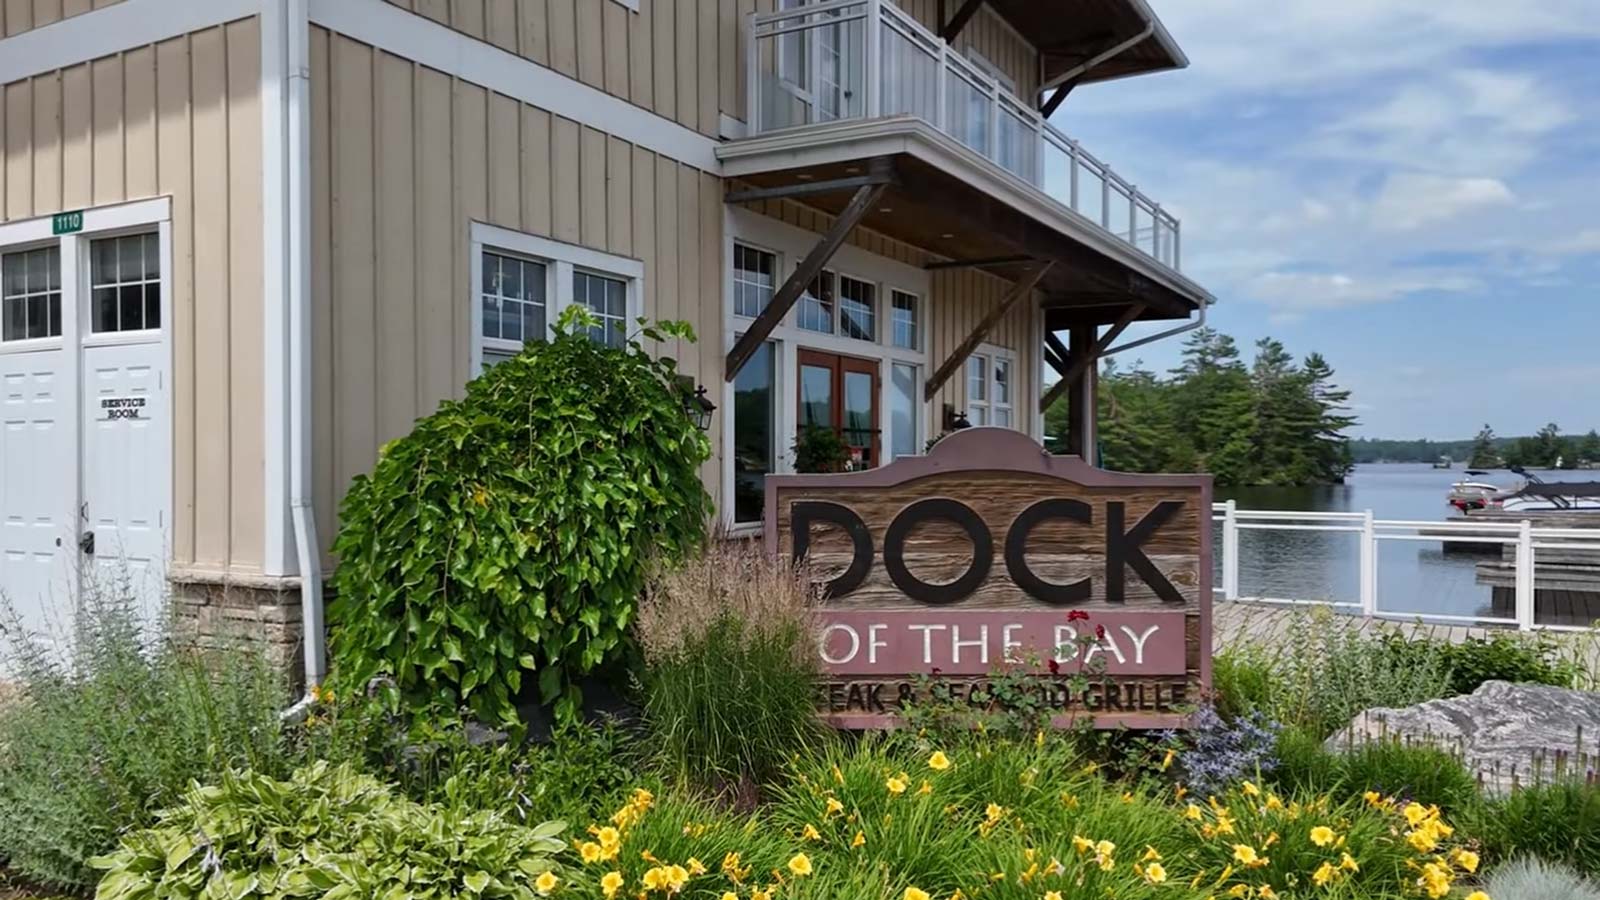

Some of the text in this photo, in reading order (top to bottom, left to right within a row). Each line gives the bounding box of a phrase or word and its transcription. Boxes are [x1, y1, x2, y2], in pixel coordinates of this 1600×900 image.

[57, 213, 80, 230] 1110
[101, 398, 145, 408] SERVICE
[107, 409, 139, 419] ROOM
[791, 497, 1186, 605] DOCK
[819, 623, 1160, 664] OF THE BAY
[1083, 683, 1186, 711] GRILLE
